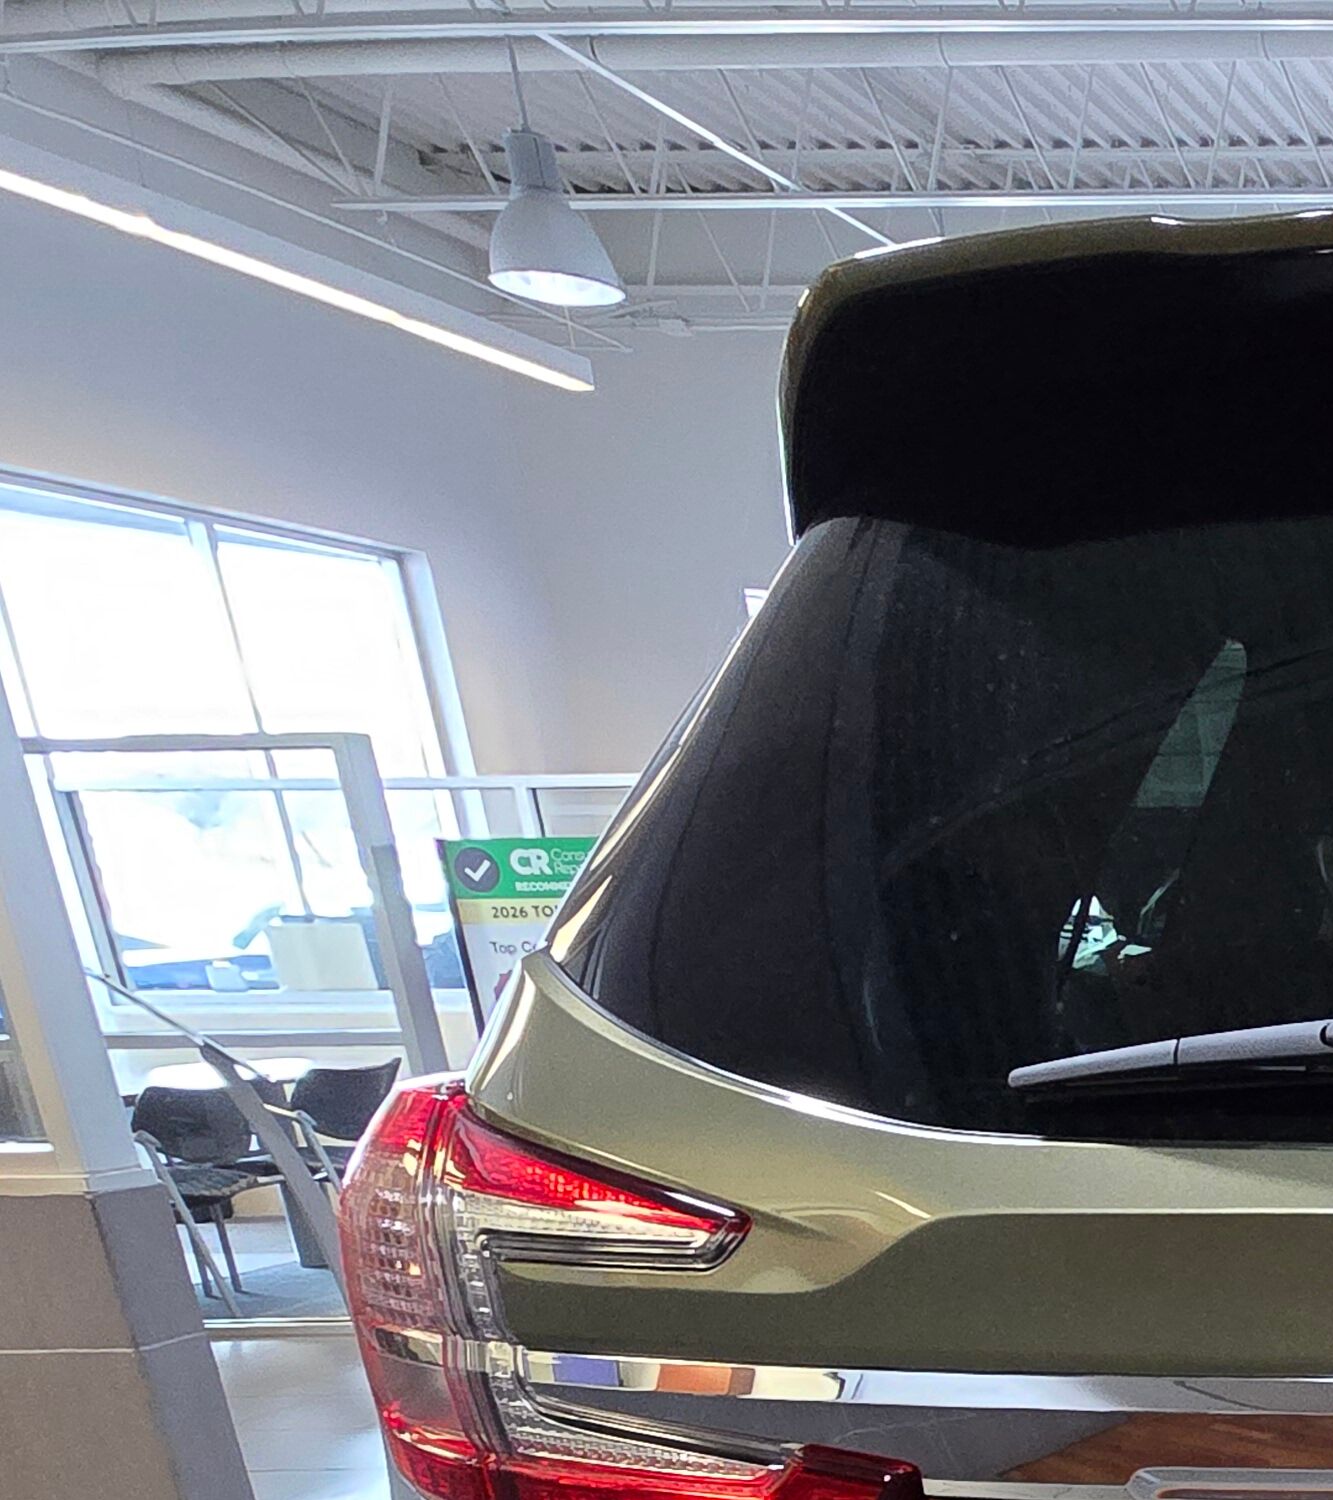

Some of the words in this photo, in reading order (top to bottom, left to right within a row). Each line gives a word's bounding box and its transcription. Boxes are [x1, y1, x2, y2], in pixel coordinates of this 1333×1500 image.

[509, 848, 553, 875] CR
[491, 906, 528, 919] 2026
[532, 905, 558, 918] TO
[489, 941, 517, 955] Top
